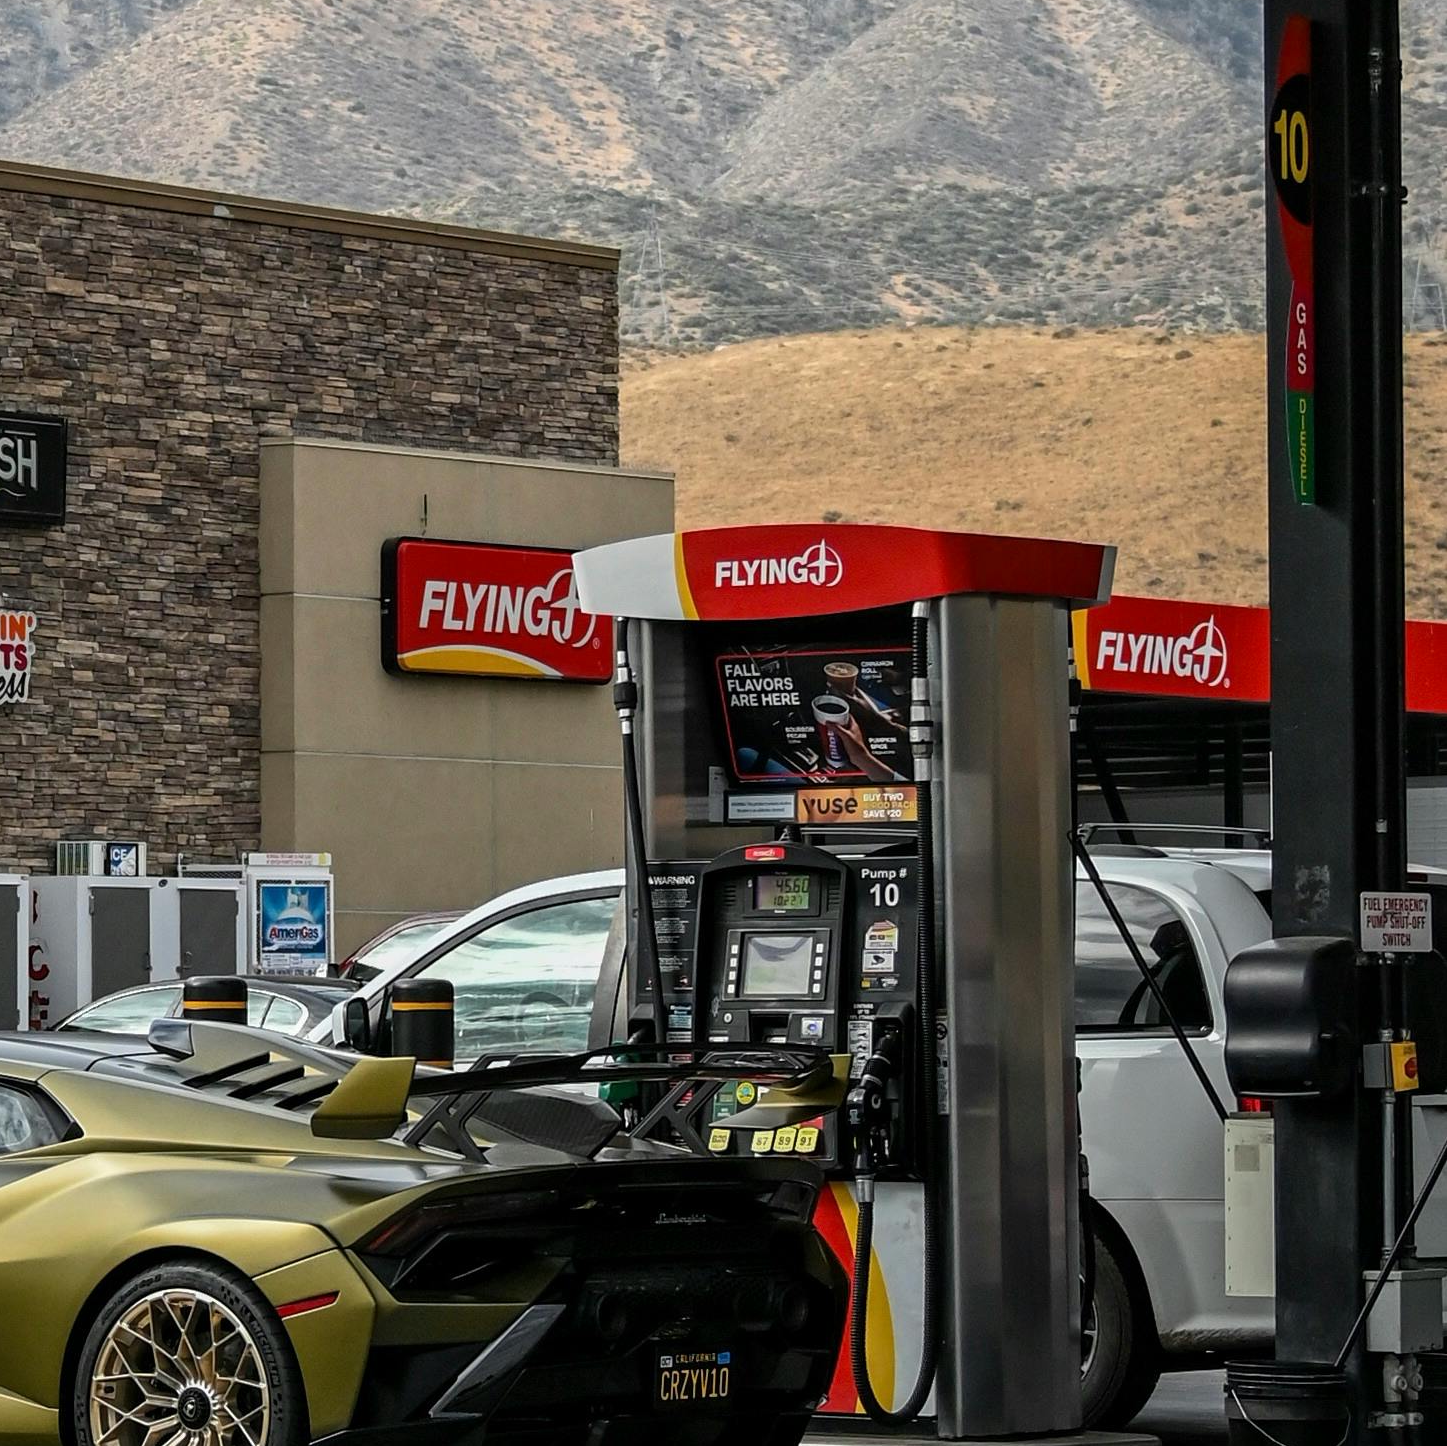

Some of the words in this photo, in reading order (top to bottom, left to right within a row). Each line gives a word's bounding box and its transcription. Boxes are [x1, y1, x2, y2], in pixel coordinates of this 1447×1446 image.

[1274, 109, 1309, 184] 10
[1295, 303, 1308, 375] GAS
[1299, 398, 1307, 496] DIESEL
[724, 663, 761, 678] FALL
[727, 677, 793, 693] FLAVORS
[730, 693, 758, 707] ARE
[761, 692, 800, 706] HERE
[863, 793, 881, 802] BUY
[882, 792, 904, 801] TWO
[863, 809, 885, 818] SAVE
[654, 875, 695, 885] WARNING
[861, 868, 897, 880] Pump
[899, 868, 907, 879] #
[869, 883, 900, 907] 10
[1363, 897, 1382, 911] FUEL
[1383, 898, 1428, 912] EMERGENCY
[1366, 915, 1388, 928] PUMP
[1390, 916, 1426, 929] SHUT-OFF
[269, 925, 319, 939] AmeriGas
[1382, 933, 1411, 946] SWITCH
[756, 1137, 768, 1145] 87
[778, 1136, 791, 1145] 89
[800, 1136, 812, 1145] 91
[675, 1352, 716, 1364] CALIFORNIA
[660, 1367, 729, 1401] CRZYV10
